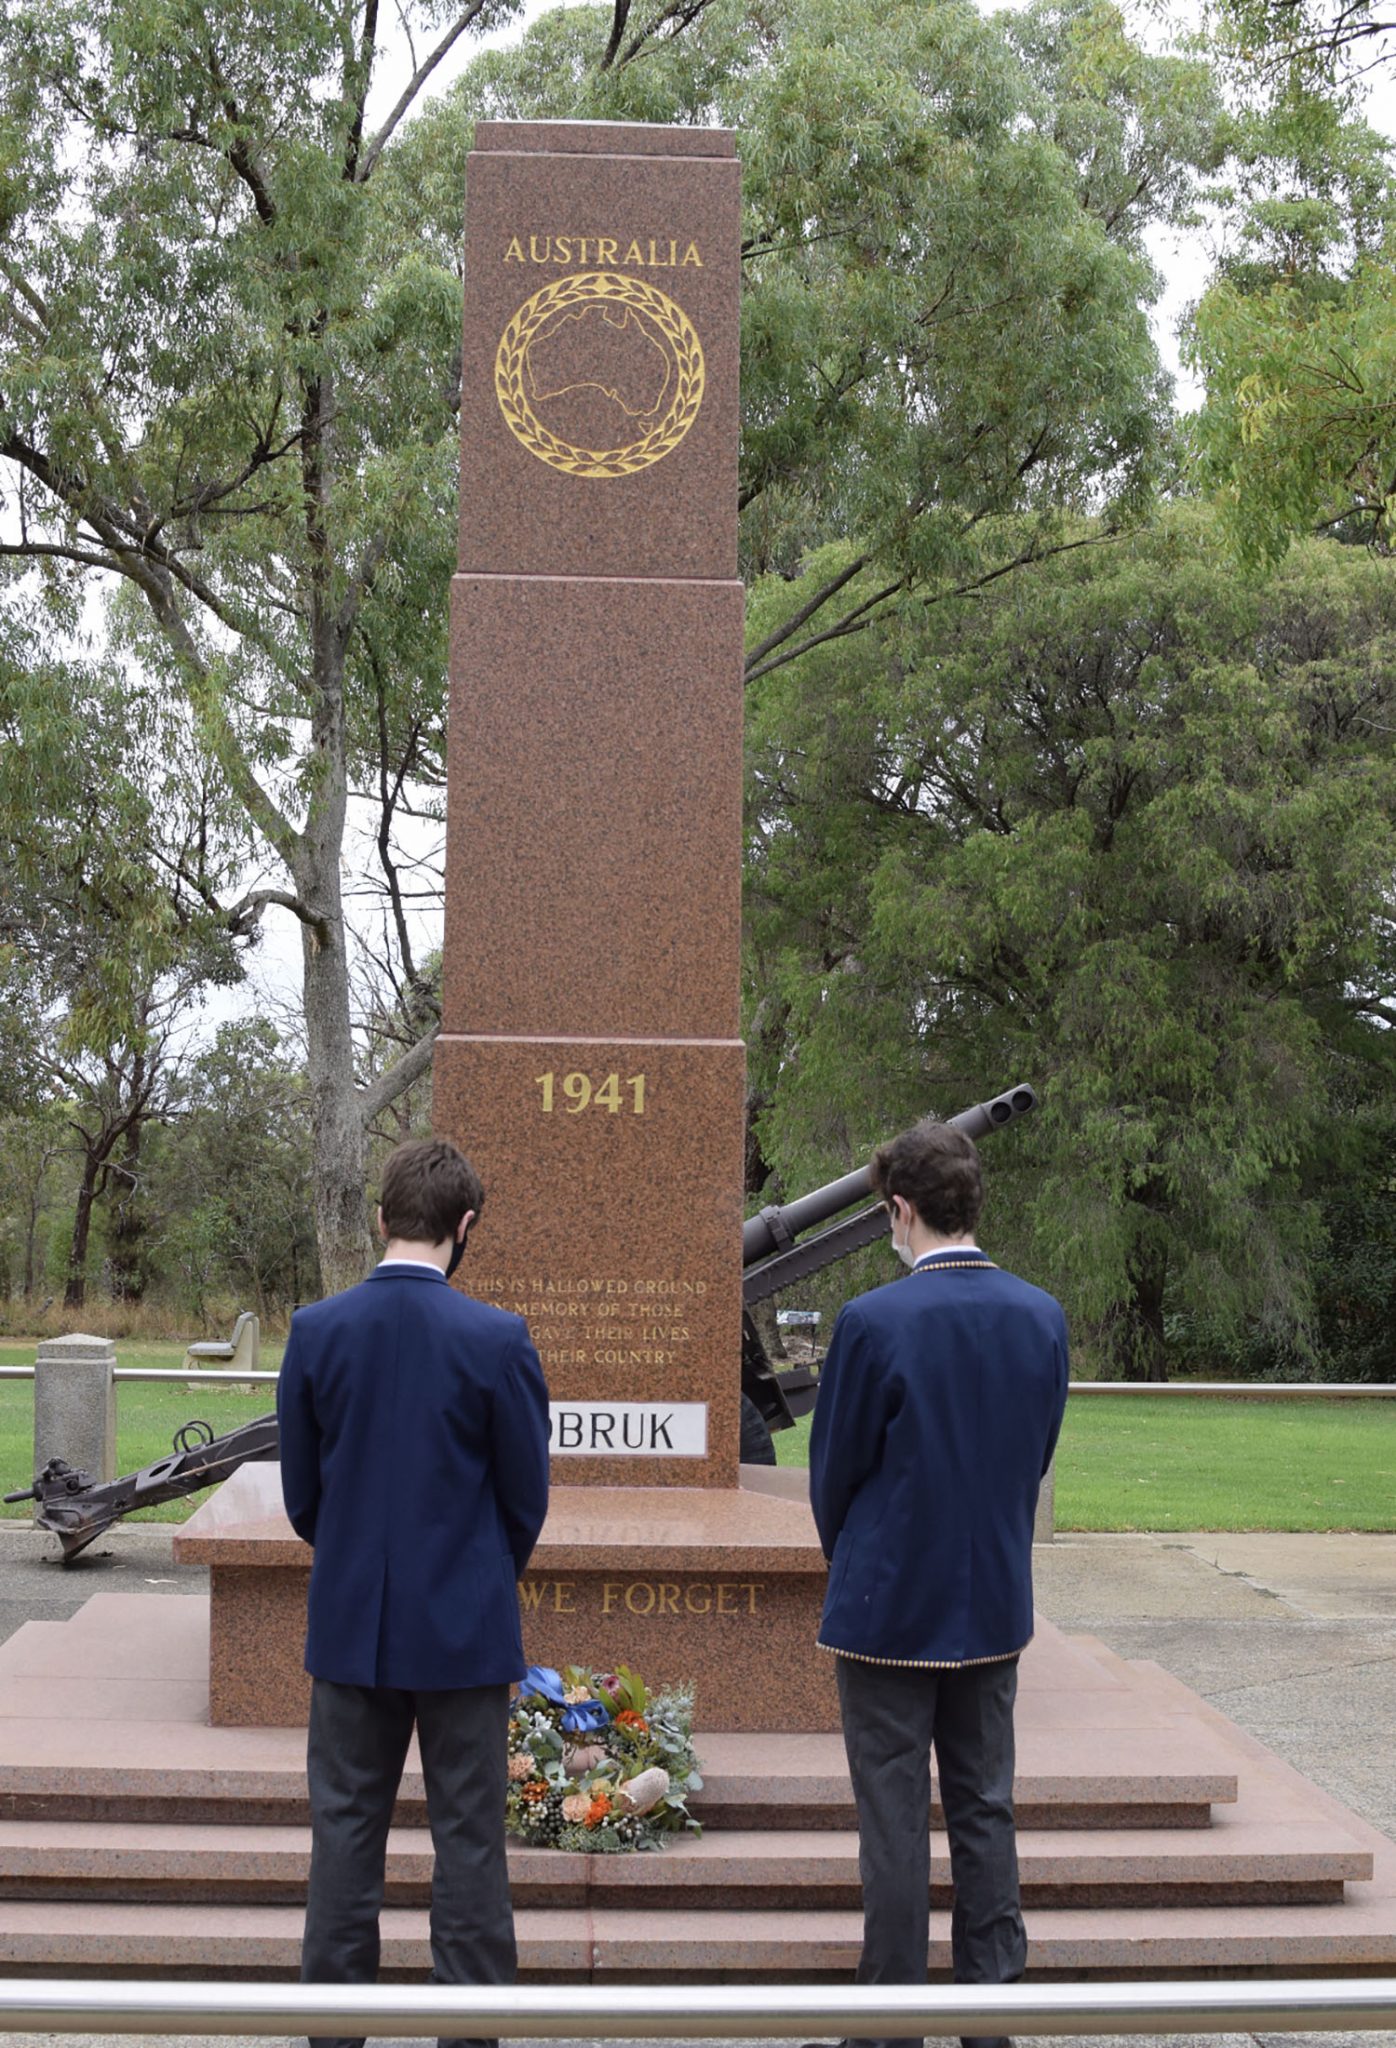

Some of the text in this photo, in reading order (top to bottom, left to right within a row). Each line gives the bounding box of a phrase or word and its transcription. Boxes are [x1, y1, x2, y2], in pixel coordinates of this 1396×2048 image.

[503, 235, 704, 267] AUSTRALIA
[534, 1071, 646, 1114] 1941
[469, 1279, 708, 1295] THIS IS HALLOWED GROUND
[514, 1302, 591, 1317] MEMORY
[599, 1303, 621, 1316] OF
[628, 1303, 685, 1318] THOSE
[530, 1325, 691, 1341] GAVE THEIR LIVES
[594, 1350, 676, 1365] COUNTRY
[548, 1412, 674, 1449] BRUK
[517, 1582, 765, 1616] WE FORGET
